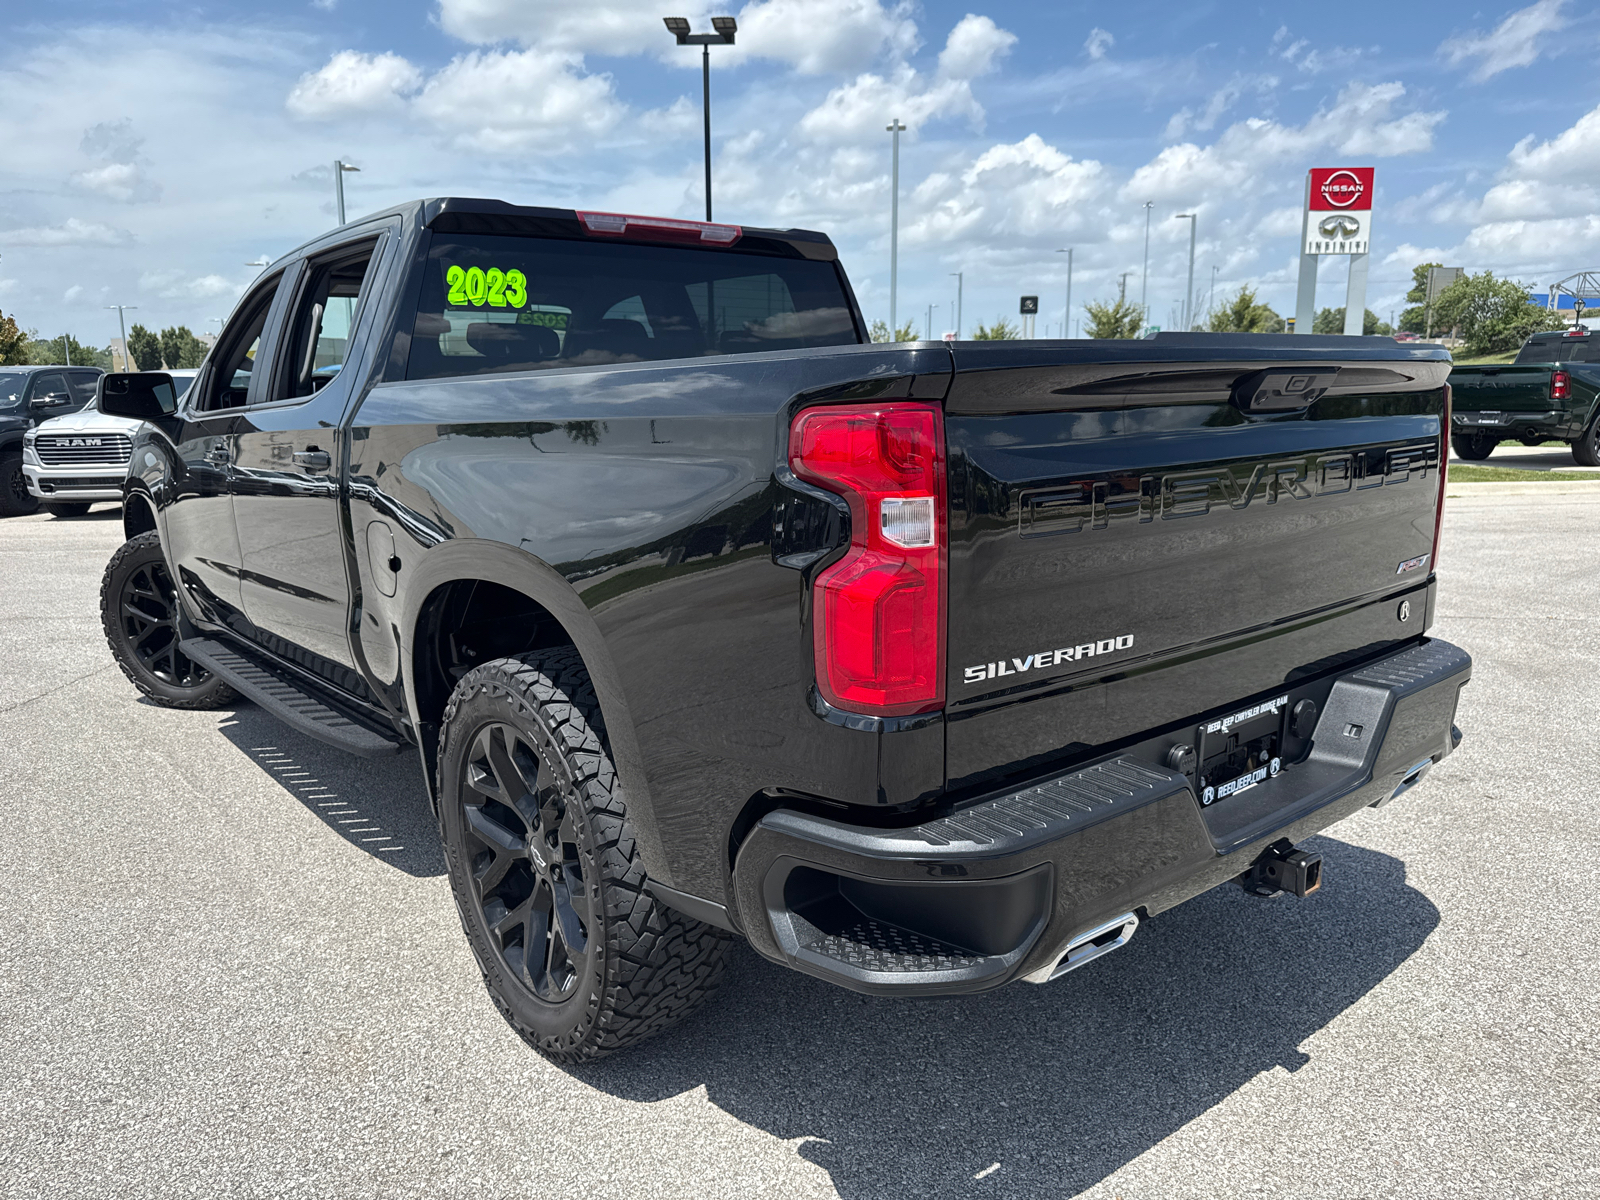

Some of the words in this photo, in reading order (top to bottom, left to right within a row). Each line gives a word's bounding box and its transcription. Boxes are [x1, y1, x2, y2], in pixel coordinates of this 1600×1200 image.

[1321, 185, 1364, 193] NISSAN
[1308, 241, 1367, 254] INFINITI
[446, 265, 528, 308] 2023
[55, 438, 102, 447] RAM
[1018, 442, 1437, 540] CHEVROLET
[963, 633, 1134, 684] SILVERADO
[1207, 720, 1221, 734] REED
[1222, 715, 1235, 728] JEEP
[1234, 706, 1260, 723] CHRYSLER
[1260, 699, 1276, 714] DODGE
[1276, 695, 1289, 707] RAM
[1217, 766, 1268, 799] REEDJEEP.COM
